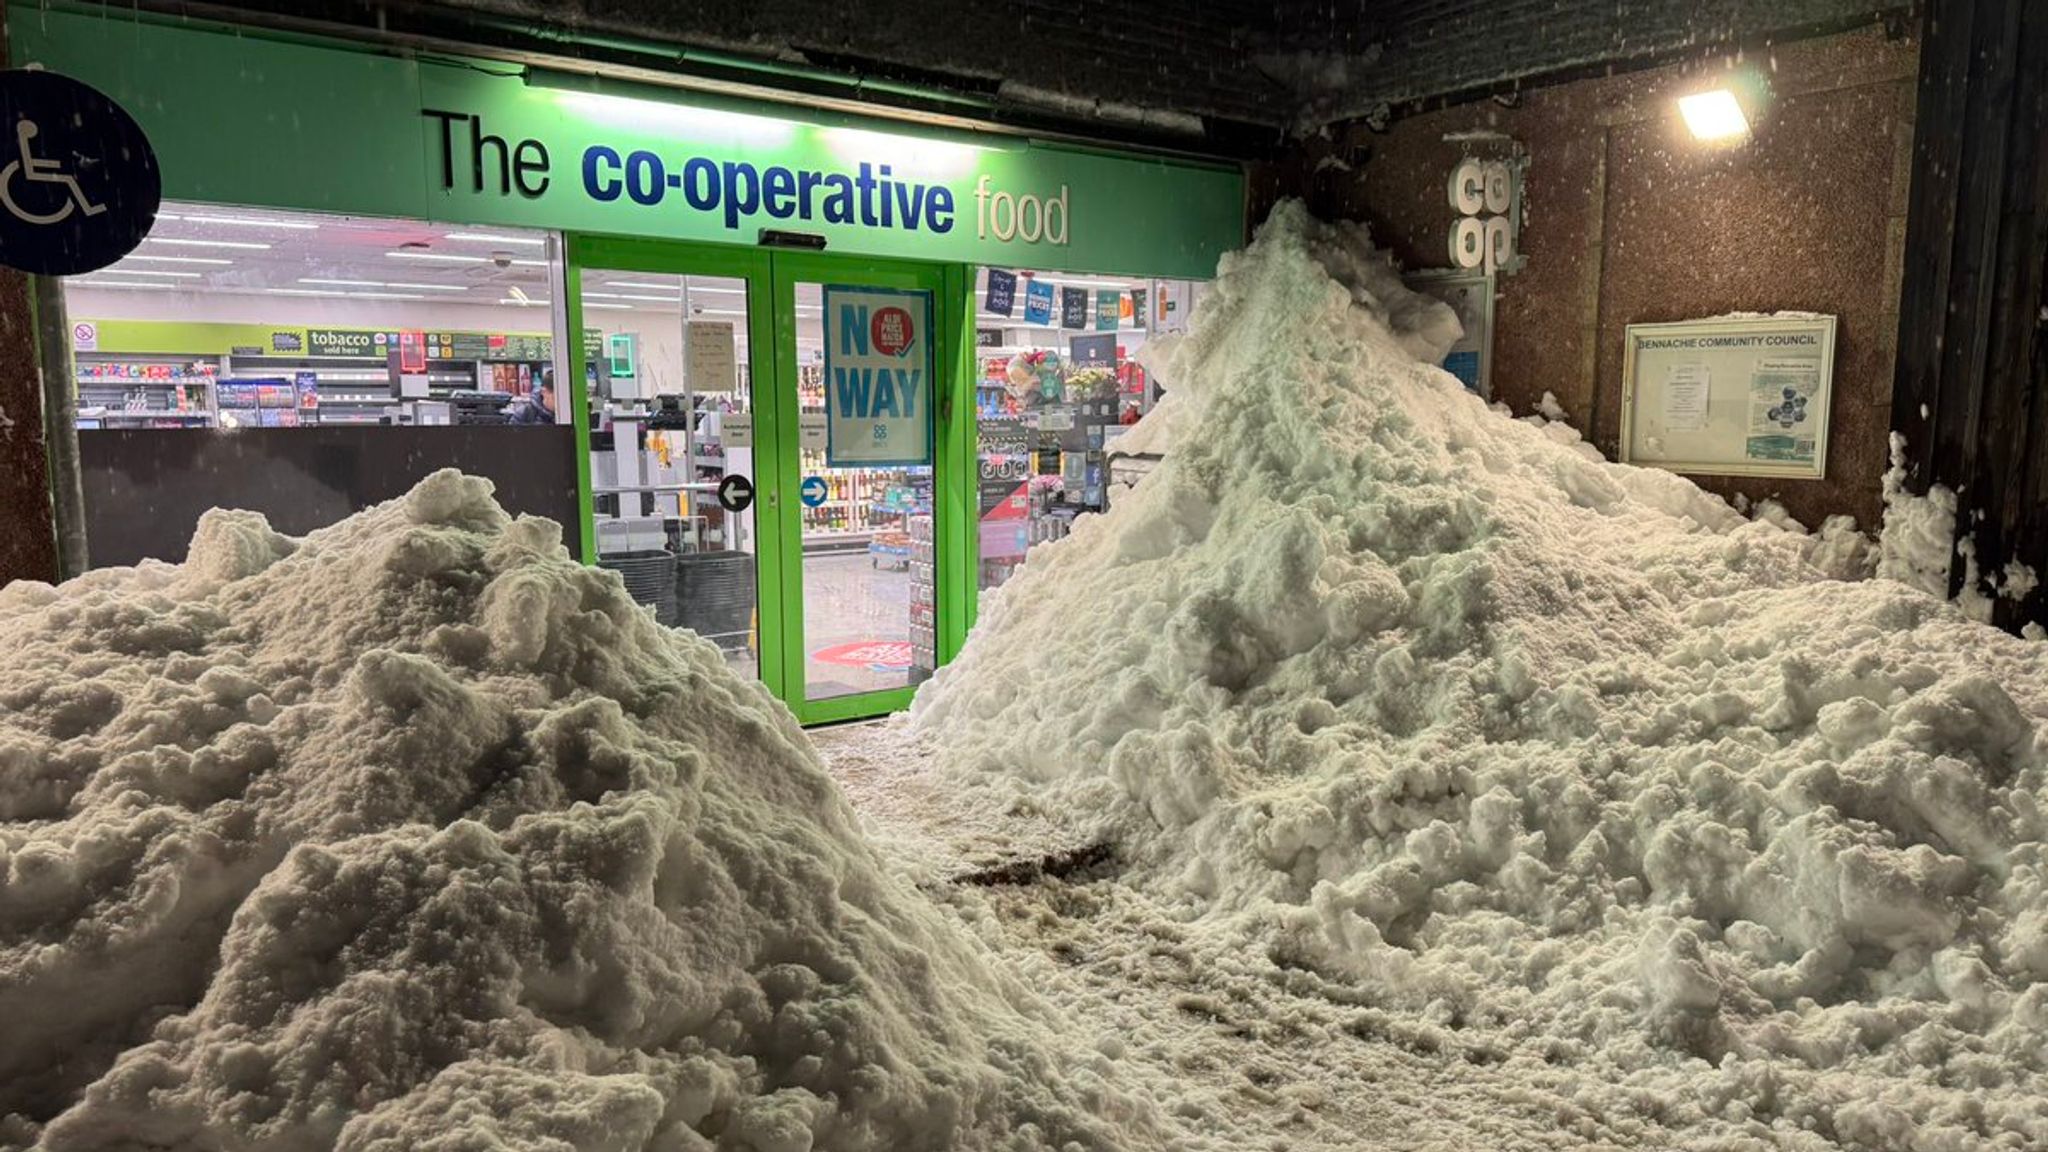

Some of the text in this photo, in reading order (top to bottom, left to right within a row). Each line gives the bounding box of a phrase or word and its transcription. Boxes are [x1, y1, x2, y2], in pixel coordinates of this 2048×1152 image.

[421, 109, 1069, 245] The co-operative food
[1449, 158, 1511, 215] co
[1449, 216, 1511, 277] op
[310, 331, 370, 346] tobacco
[323, 346, 360, 355] sold here
[1698, 336, 1763, 348] COMMUNITY
[1766, 334, 1817, 346] COUNCIL
[834, 367, 922, 418] WAY
